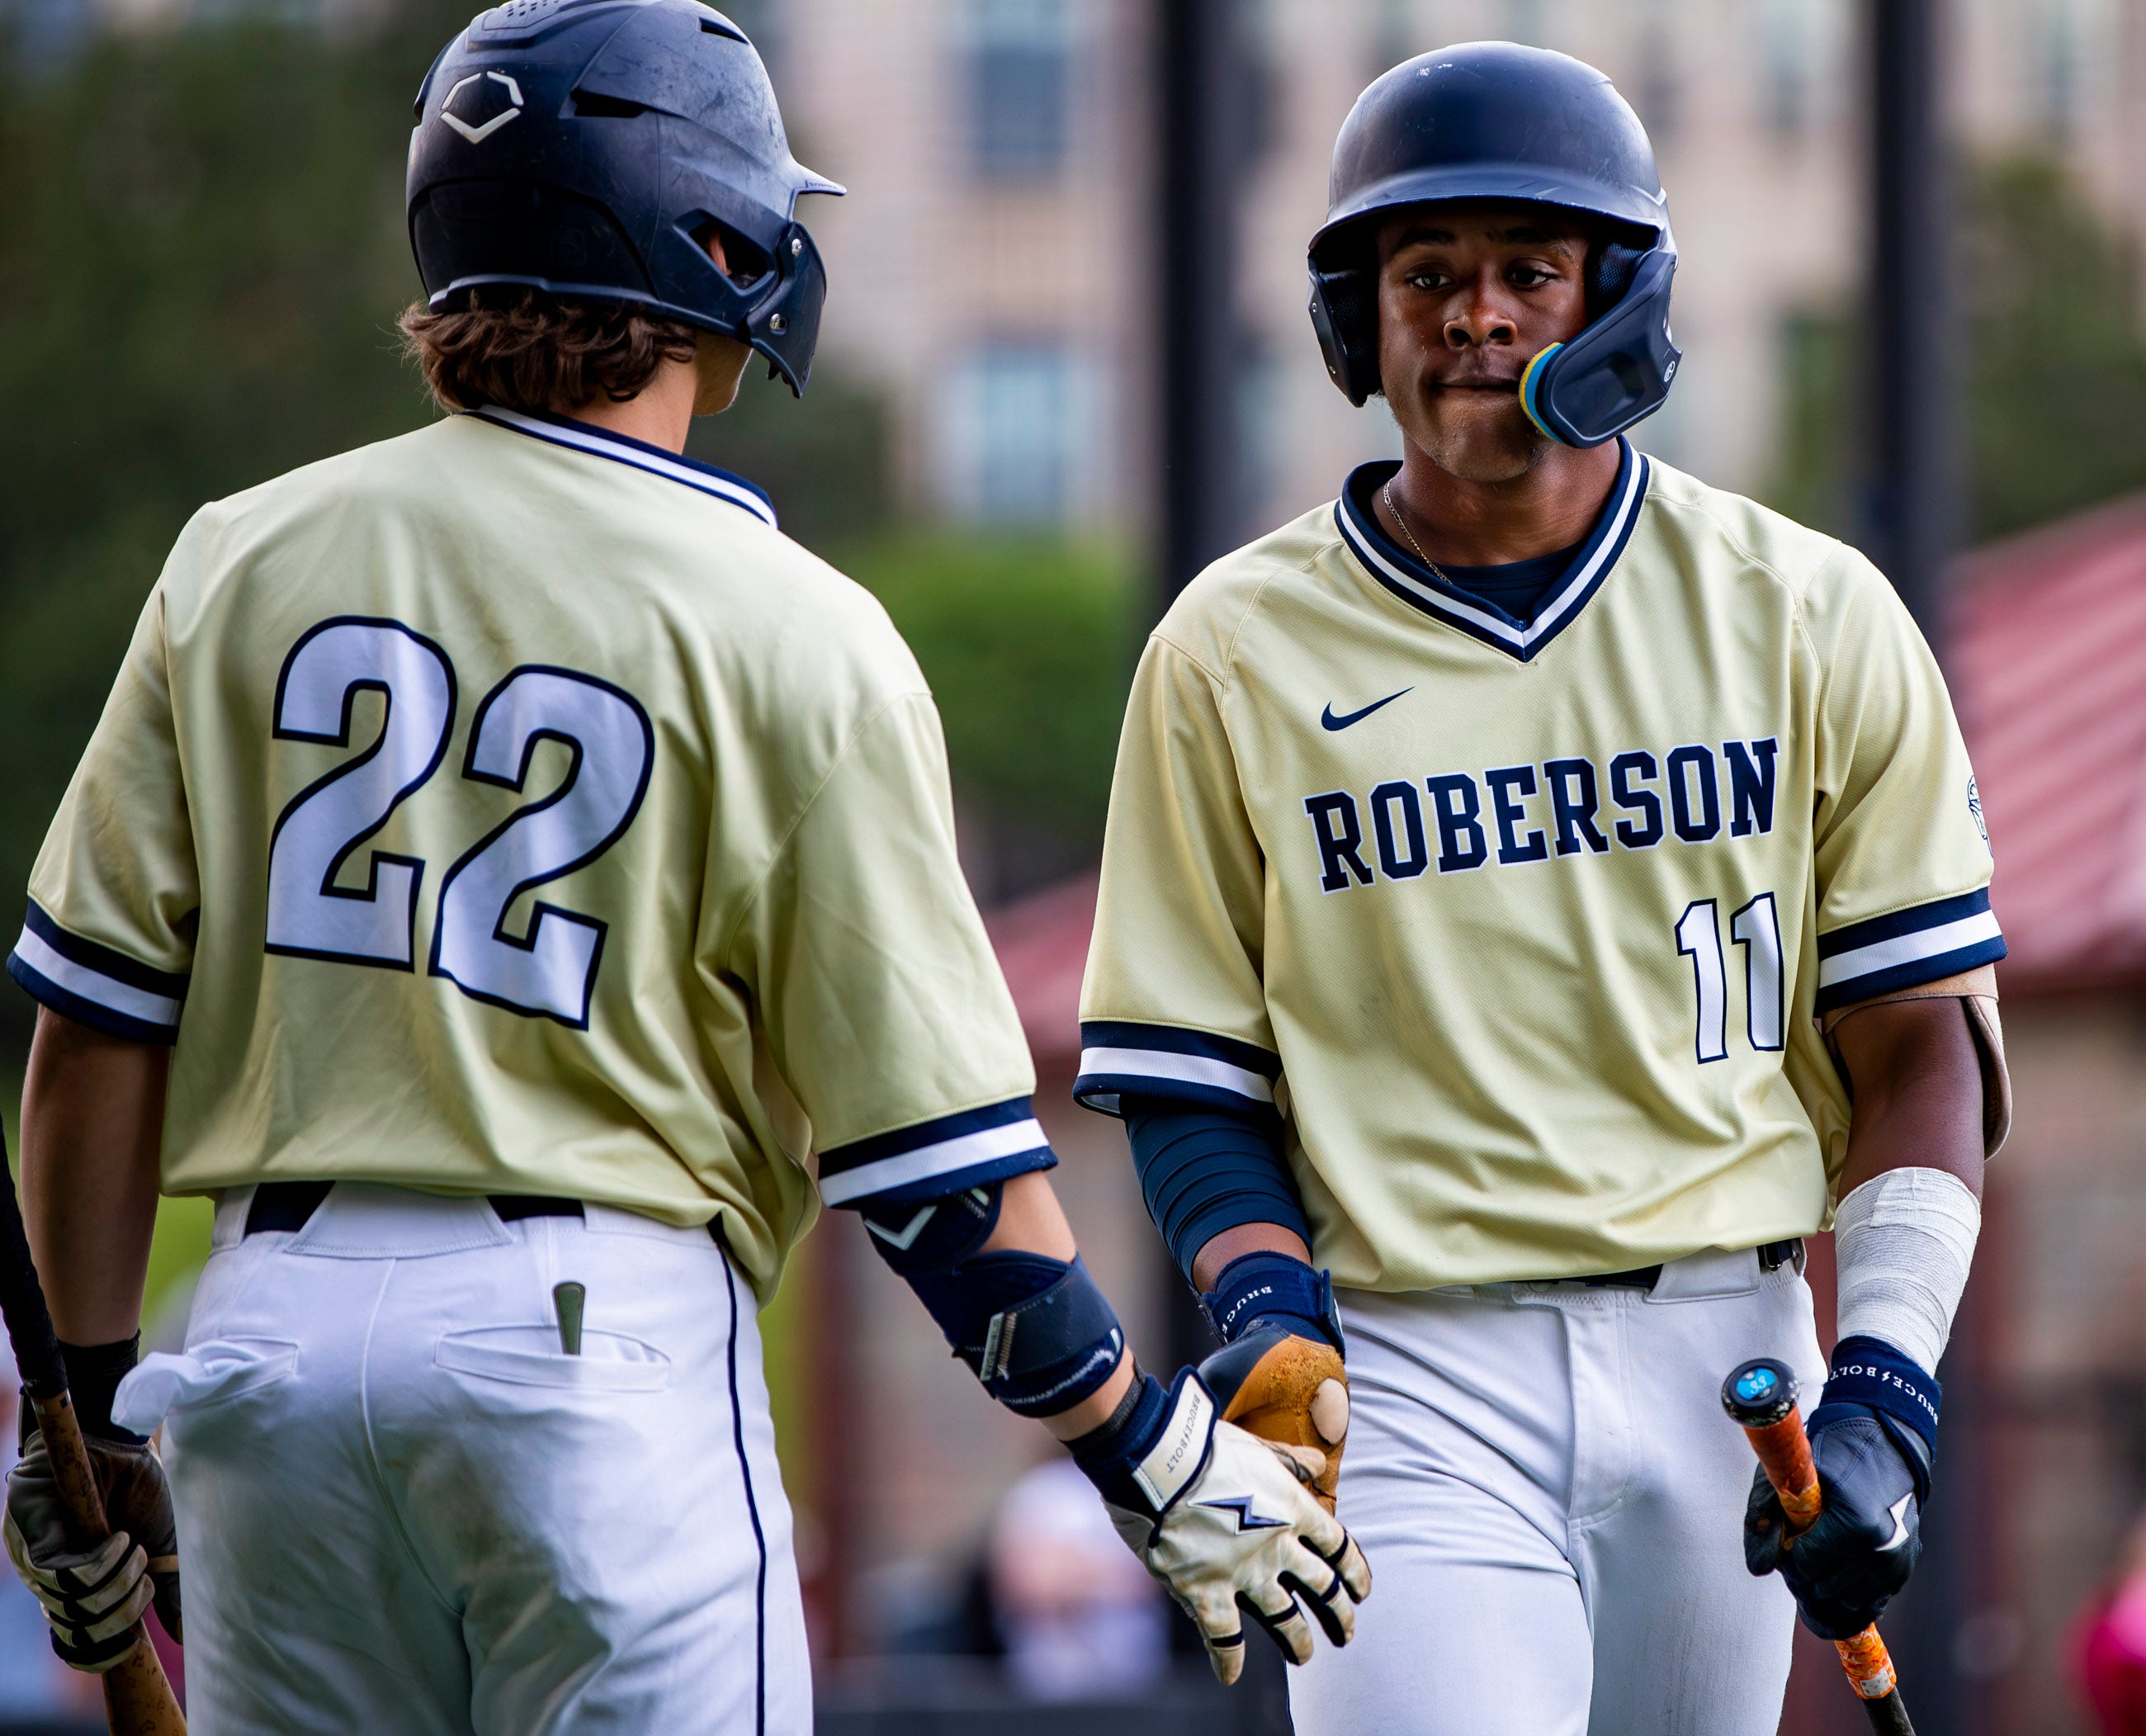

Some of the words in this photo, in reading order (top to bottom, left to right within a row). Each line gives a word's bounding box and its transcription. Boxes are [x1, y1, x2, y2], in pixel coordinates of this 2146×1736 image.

[264, 615, 655, 1032] 22
[1302, 736, 1780, 894] ROBERSON
[1675, 891, 1785, 1065] 11
